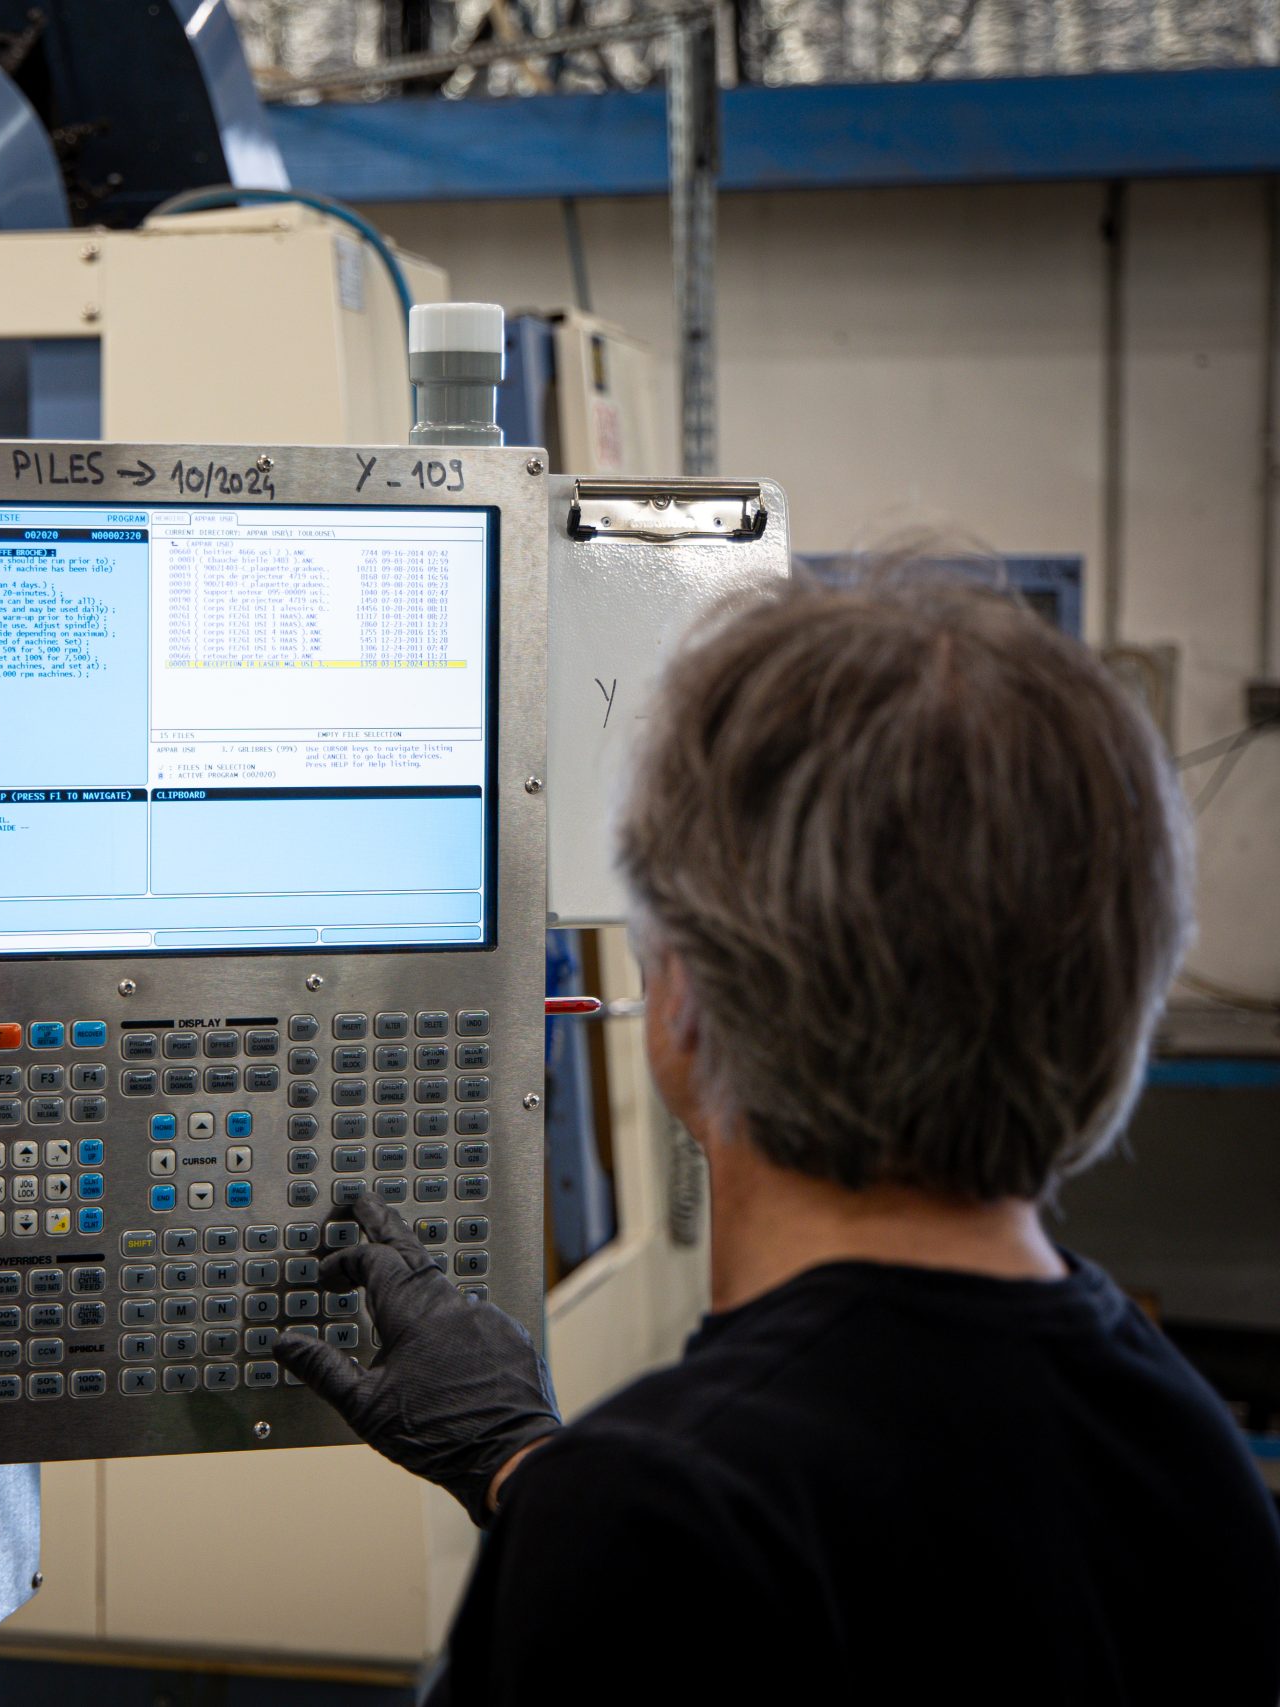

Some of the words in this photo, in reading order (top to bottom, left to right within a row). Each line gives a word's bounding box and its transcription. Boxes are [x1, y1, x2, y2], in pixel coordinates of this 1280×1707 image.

[13, 450, 104, 484] PILES
[170, 460, 275, 500] 10/2024
[355, 453, 377, 492] Y
[412, 459, 465, 491] 109
[12, 792, 45, 801] (PRESS
[83, 791, 132, 800] NAVIGATE)
[179, 1019, 221, 1028] DISPLAY
[41, 1073, 55, 1083] F3
[83, 1072, 96, 1082] F4
[182, 1157, 217, 1165] CURSOR
[20, 1180, 33, 1188] JOG
[18, 1189, 35, 1197] LOCK
[339, 1230, 347, 1240] E
[429, 1225, 436, 1238] 8
[470, 1224, 478, 1236] 9
[177, 1237, 186, 1247] A
[218, 1236, 226, 1246] B
[259, 1234, 267, 1244] C
[299, 1232, 308, 1242] D
[127, 1240, 152, 1248] SHIFT
[470, 1257, 478, 1270] 6
[177, 1271, 186, 1281] G
[218, 1270, 226, 1279] H
[300, 1266, 307, 1276] J
[137, 1273, 144, 1284] F
[258, 1302, 267, 1312] O
[300, 1300, 308, 1309] P
[338, 1298, 348, 1309] Q
[137, 1308, 144, 1318] L
[177, 1306, 186, 1316] M
[218, 1304, 226, 1314] N
[259, 1336, 267, 1345] U
[337, 1332, 348, 1341] W
[137, 1342, 144, 1351] R
[177, 1340, 185, 1349] S
[218, 1338, 226, 1347] T
[69, 1345, 104, 1353] SPINDLE
[136, 1376, 144, 1386] X
[177, 1374, 185, 1384] Y
[218, 1372, 226, 1381] Z
